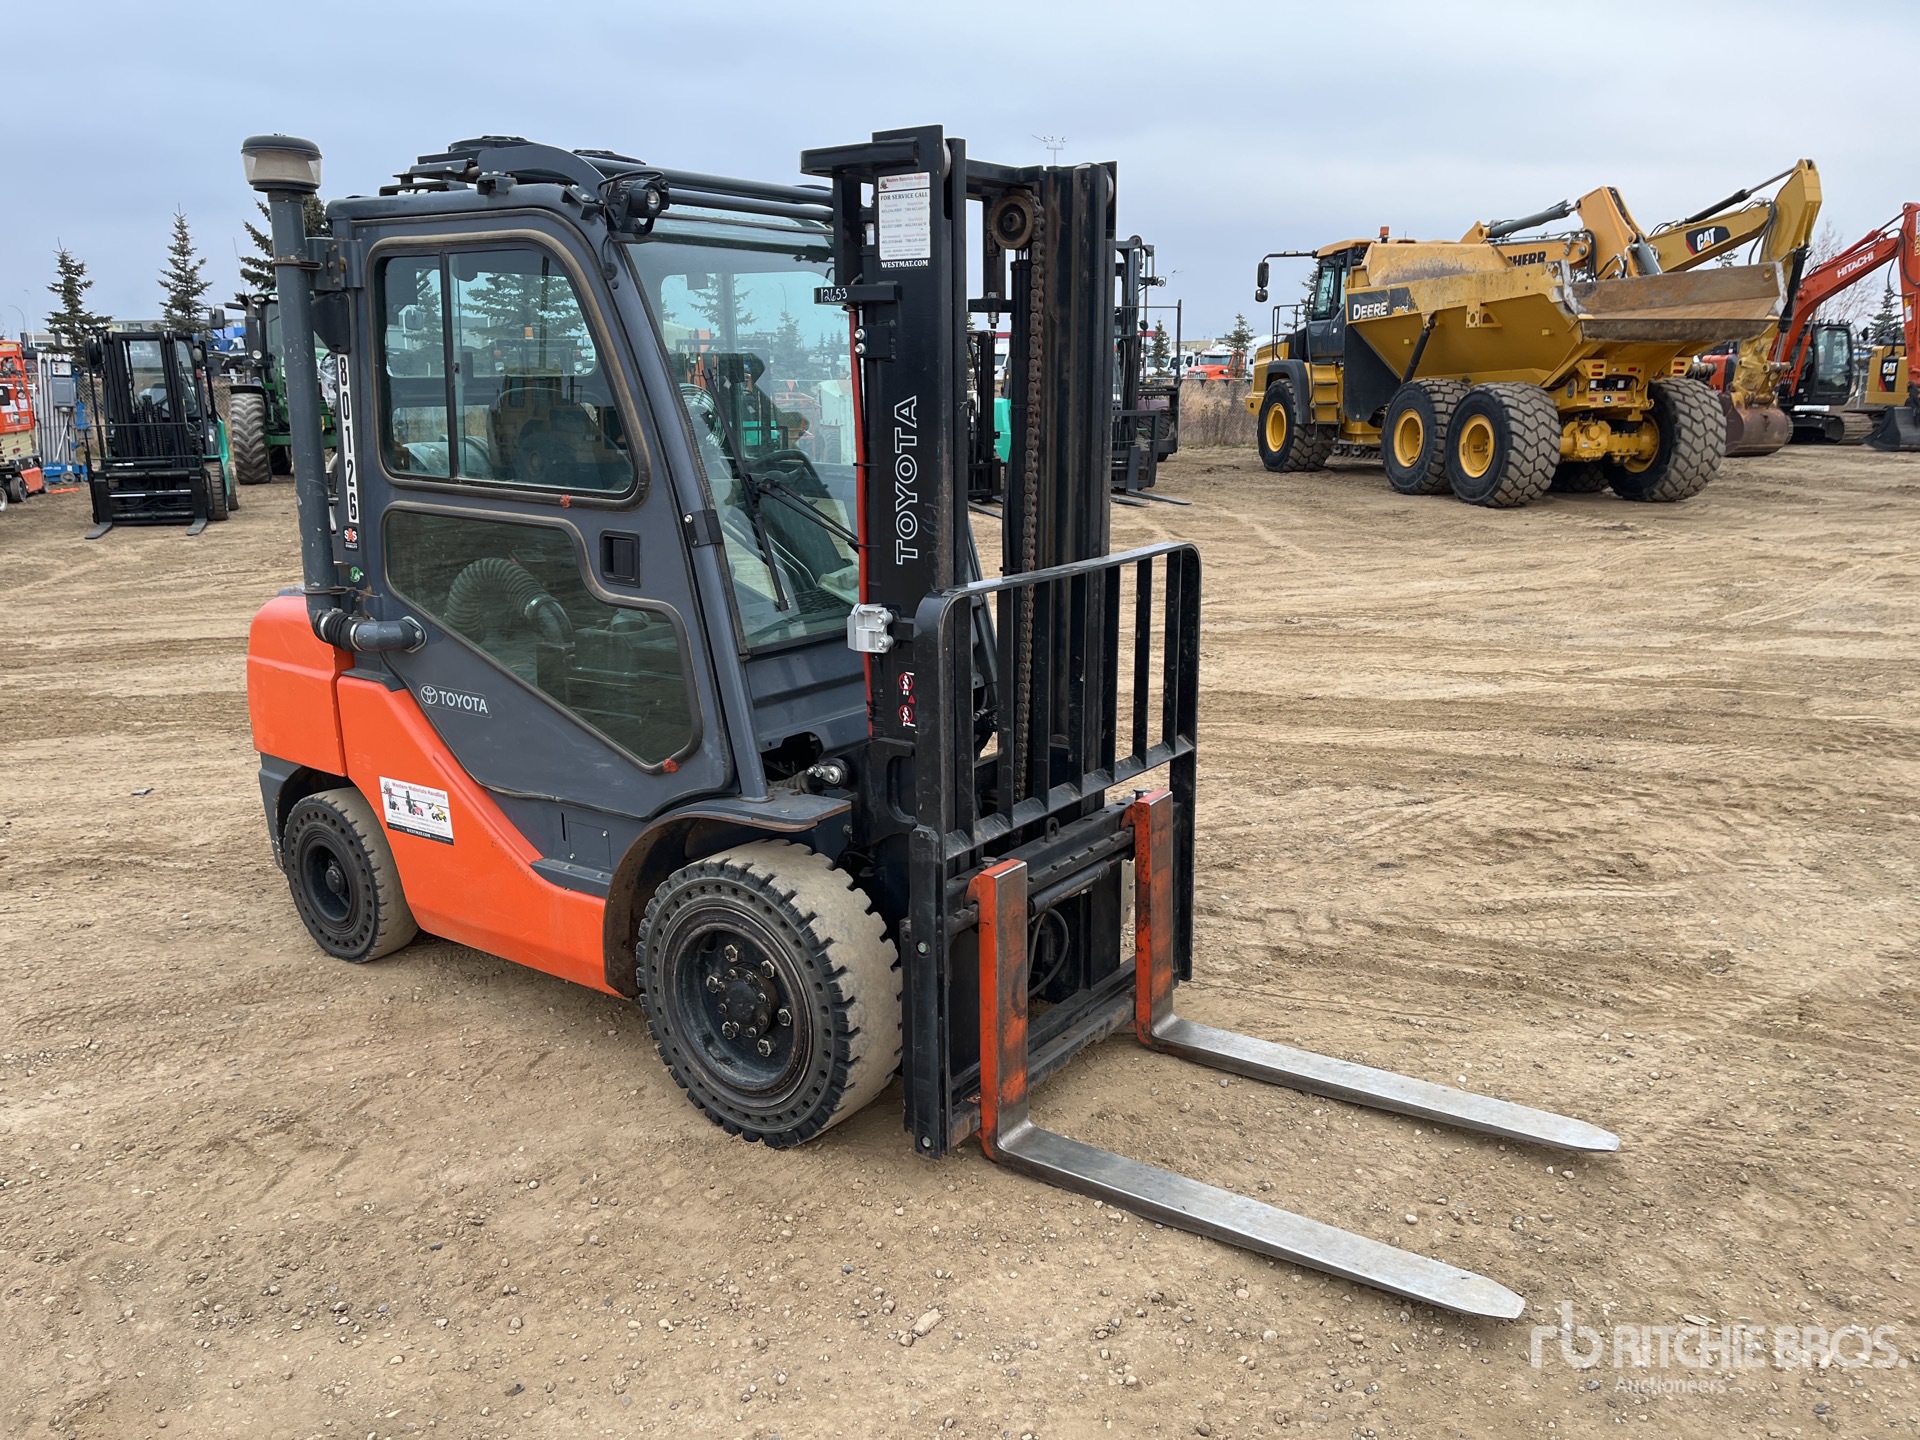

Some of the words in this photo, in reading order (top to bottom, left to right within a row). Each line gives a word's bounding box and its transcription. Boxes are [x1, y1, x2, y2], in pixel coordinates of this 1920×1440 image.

[1697, 227, 1715, 251] CAT
[881, 260, 929, 268] WESTMAT.COM
[1507, 251, 1546, 266] HERR
[1837, 251, 1874, 278] HITACHI
[821, 288, 847, 302] 12653
[1353, 302, 1388, 320] DEERE
[1882, 362, 1897, 374] CAT
[340, 357, 358, 520] 80126
[894, 395, 918, 565] TOYOTA
[344, 528, 358, 543] SAS
[439, 690, 488, 714] TOYOTA
